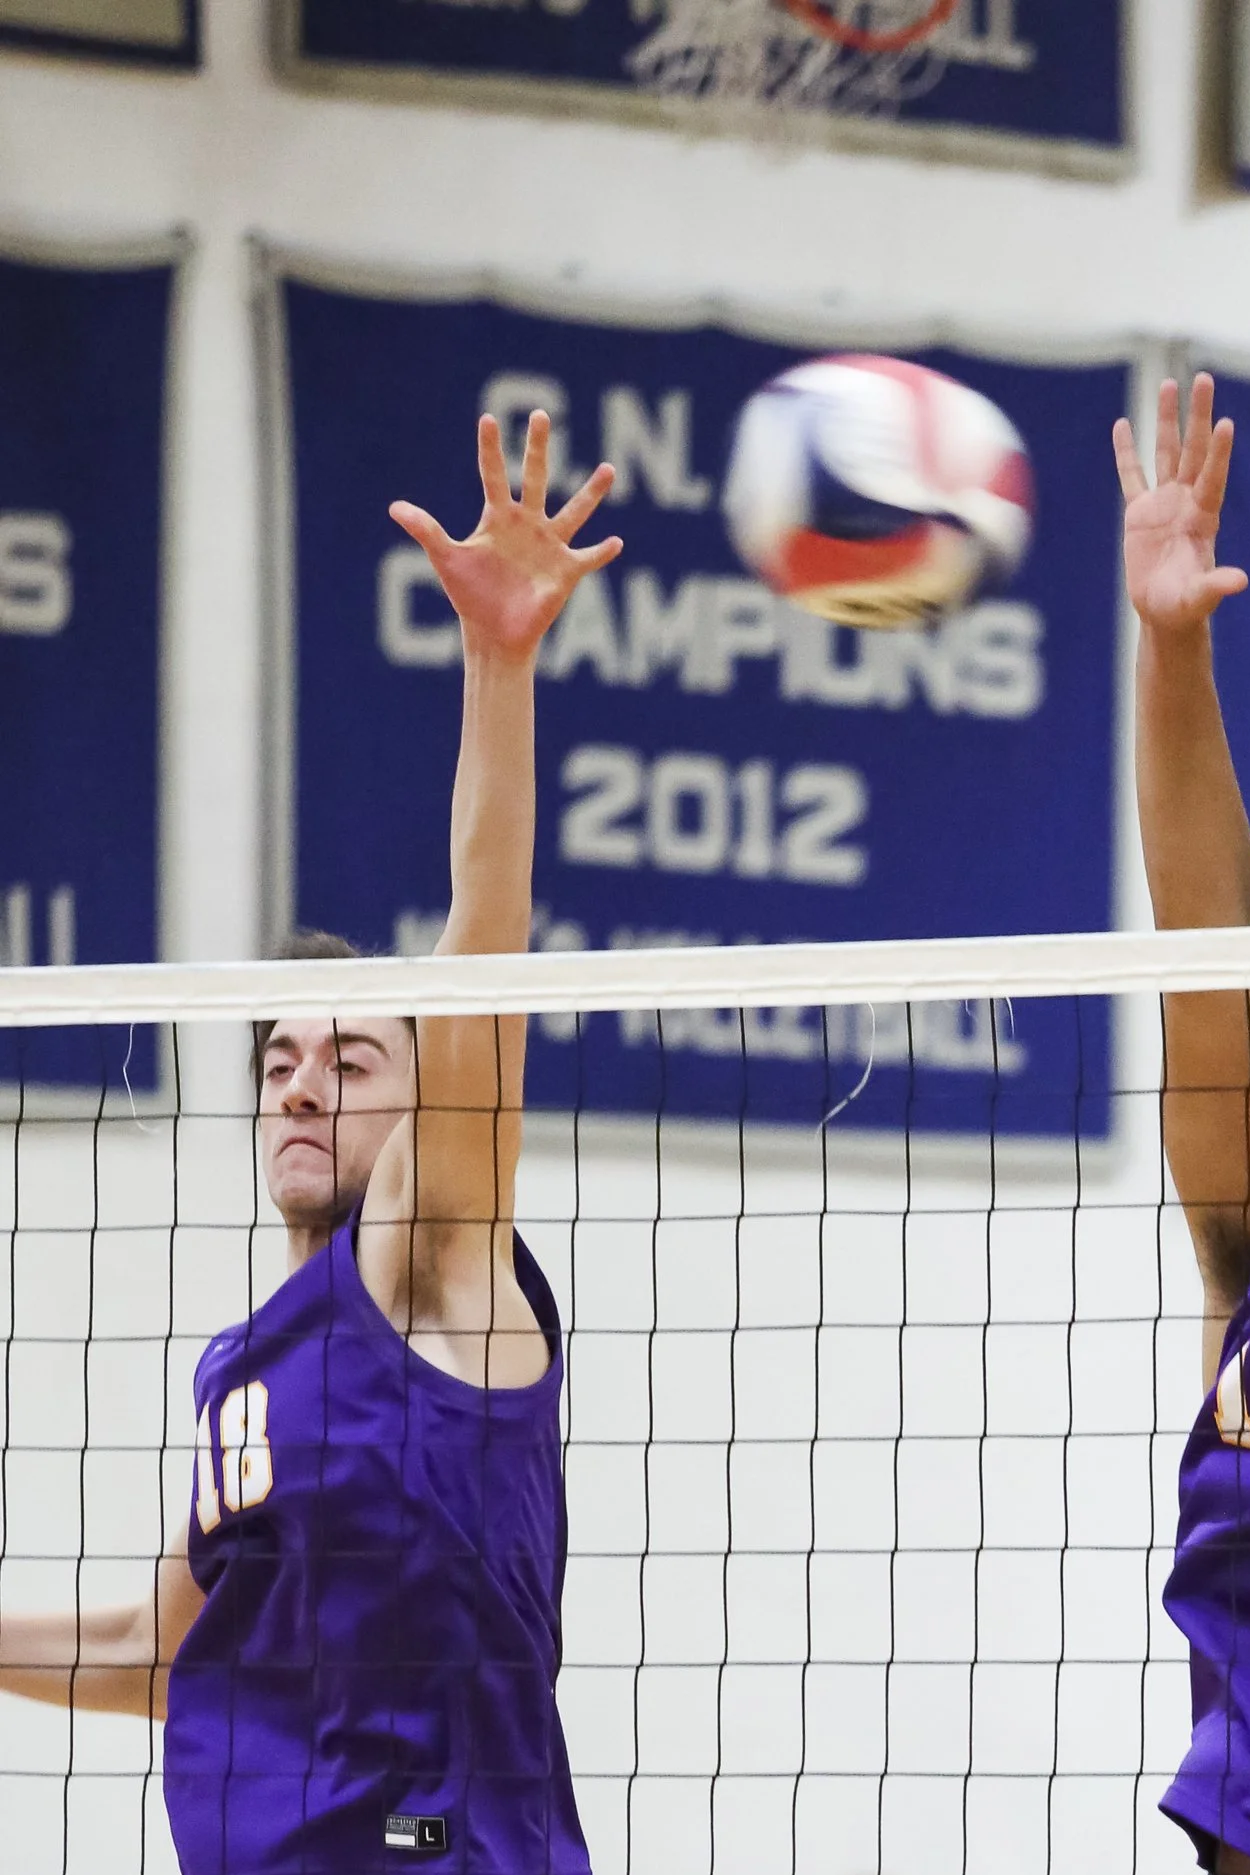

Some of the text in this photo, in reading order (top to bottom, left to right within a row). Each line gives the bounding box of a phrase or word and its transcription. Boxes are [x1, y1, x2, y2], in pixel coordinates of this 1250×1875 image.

[376, 540, 1044, 722] CAMPIONS
[557, 742, 872, 888] 2012
[195, 1378, 275, 1537] 18
[425, 1825, 436, 1842] L
